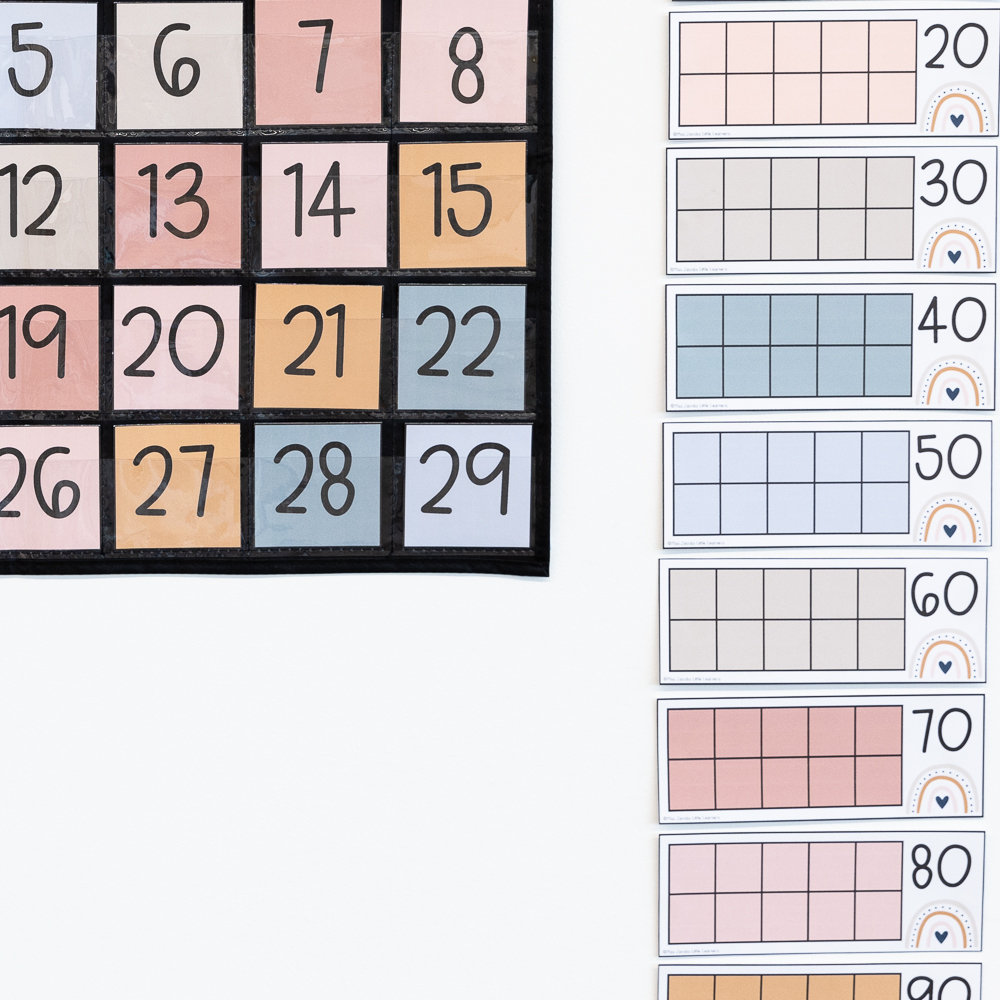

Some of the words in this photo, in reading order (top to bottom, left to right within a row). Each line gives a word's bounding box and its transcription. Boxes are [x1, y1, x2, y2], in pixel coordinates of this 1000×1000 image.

[8, 22, 53, 97] 5
[154, 23, 200, 97] 6
[298, 19, 333, 93] 7
[449, 27, 484, 104] 8
[924, 23, 988, 68] 20
[138, 162, 209, 239] 13
[284, 161, 355, 237] 14
[422, 162, 492, 237] 15
[920, 159, 987, 206] 30
[122, 305, 224, 377] 20
[284, 304, 345, 377] 21
[416, 305, 501, 377] 22
[918, 296, 986, 343] 40
[133, 445, 214, 517] 27
[274, 442, 355, 516] 28
[420, 442, 510, 515] 29
[916, 434, 982, 480] 50
[911, 571, 978, 617] 60
[913, 708, 972, 753] 70
[912, 844, 971, 889] 80
